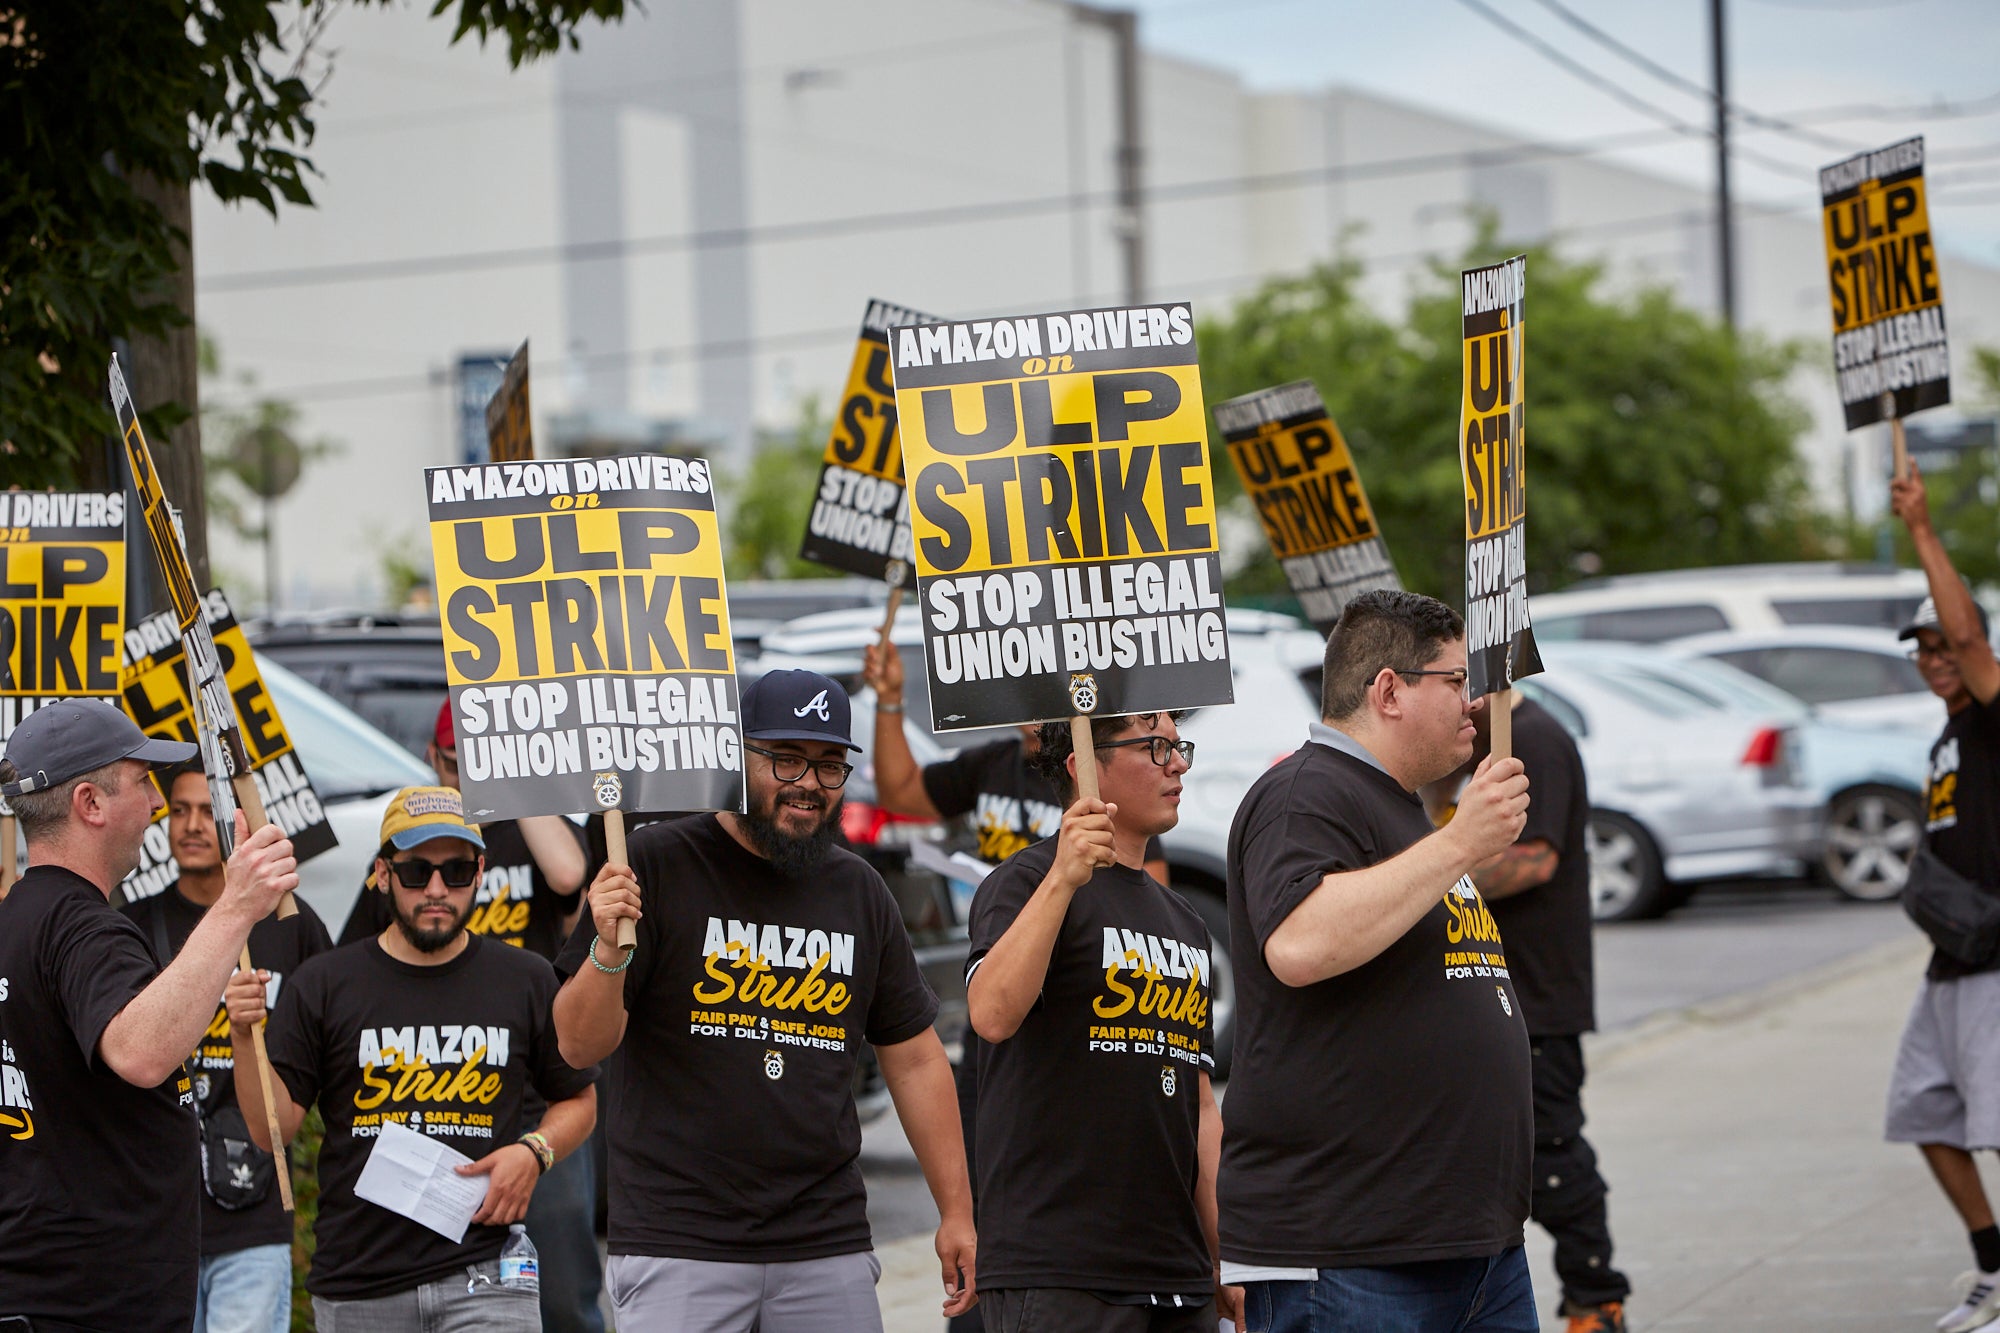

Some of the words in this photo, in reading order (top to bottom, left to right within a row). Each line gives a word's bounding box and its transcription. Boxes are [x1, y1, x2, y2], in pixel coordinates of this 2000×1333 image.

[1830, 185, 1917, 250] ULP
[1464, 267, 1506, 316] AMAZON
[1830, 232, 1937, 327] STRIKE
[898, 317, 1041, 369] AMAZON
[1047, 305, 1193, 355] DRIVERS
[1021, 354, 1075, 375] on
[921, 371, 1182, 456] ULP
[431, 463, 570, 504] AMAZON
[574, 456, 710, 494] DRIVERS
[1237, 426, 1332, 484] ULP
[13, 492, 124, 527] DRIVERS
[550, 492, 601, 510] on
[821, 466, 898, 513] STOP
[915, 442, 1211, 572] STRIKE
[1252, 469, 1372, 554] STRIKE
[453, 511, 701, 580] ULP
[810, 501, 891, 556] UNION
[0, 546, 108, 599] LP
[928, 572, 1042, 632] STOP
[1051, 557, 1220, 620] ILLEGAL
[1469, 537, 1502, 599] STOP
[124, 590, 230, 662] DRIVS
[447, 575, 729, 681] STRIKE
[933, 624, 1059, 685] UNION
[1060, 613, 1226, 671] BUSTING
[1468, 594, 1504, 654] UNION
[459, 682, 568, 734] STOP
[576, 677, 737, 725] ILLEGAL
[794, 689, 830, 722] A
[462, 728, 582, 781] UNION
[586, 726, 741, 772] BUSTING
[476, 864, 534, 904] ZON
[702, 916, 855, 976] AMAZON
[1102, 926, 1210, 988] AMAZON
[1445, 952, 1468, 966] FAIR
[1446, 967, 1473, 980] FOR
[693, 940, 851, 1015] Strike
[358, 1025, 509, 1068] AMAZON
[690, 1011, 727, 1025] FAIR
[728, 1013, 758, 1027] PAY
[759, 1017, 769, 1029] &
[770, 1020, 806, 1035] SAFE
[808, 1024, 846, 1040] JOBS
[690, 1025, 727, 1037] FOR
[734, 1027, 768, 1040] DIL7
[774, 1033, 845, 1051] DRIVERS!
[1089, 1026, 1126, 1039] FAIR
[1128, 1028, 1155, 1041] PAY
[1156, 1030, 1166, 1043] &
[1167, 1031, 1189, 1048] SAFE
[1089, 1041, 1127, 1053] FOR
[1134, 1042, 1165, 1056] DIL7
[1169, 1046, 1200, 1065] DRIVE
[354, 1044, 502, 1110] Strike
[352, 1126, 380, 1138] FOR
[426, 1125, 493, 1138] DRIVERS!
[353, 1112, 379, 1127] FAIR
[410, 1111, 422, 1124] &
[424, 1111, 461, 1125] SAFE
[463, 1113, 493, 1127] JOBS
